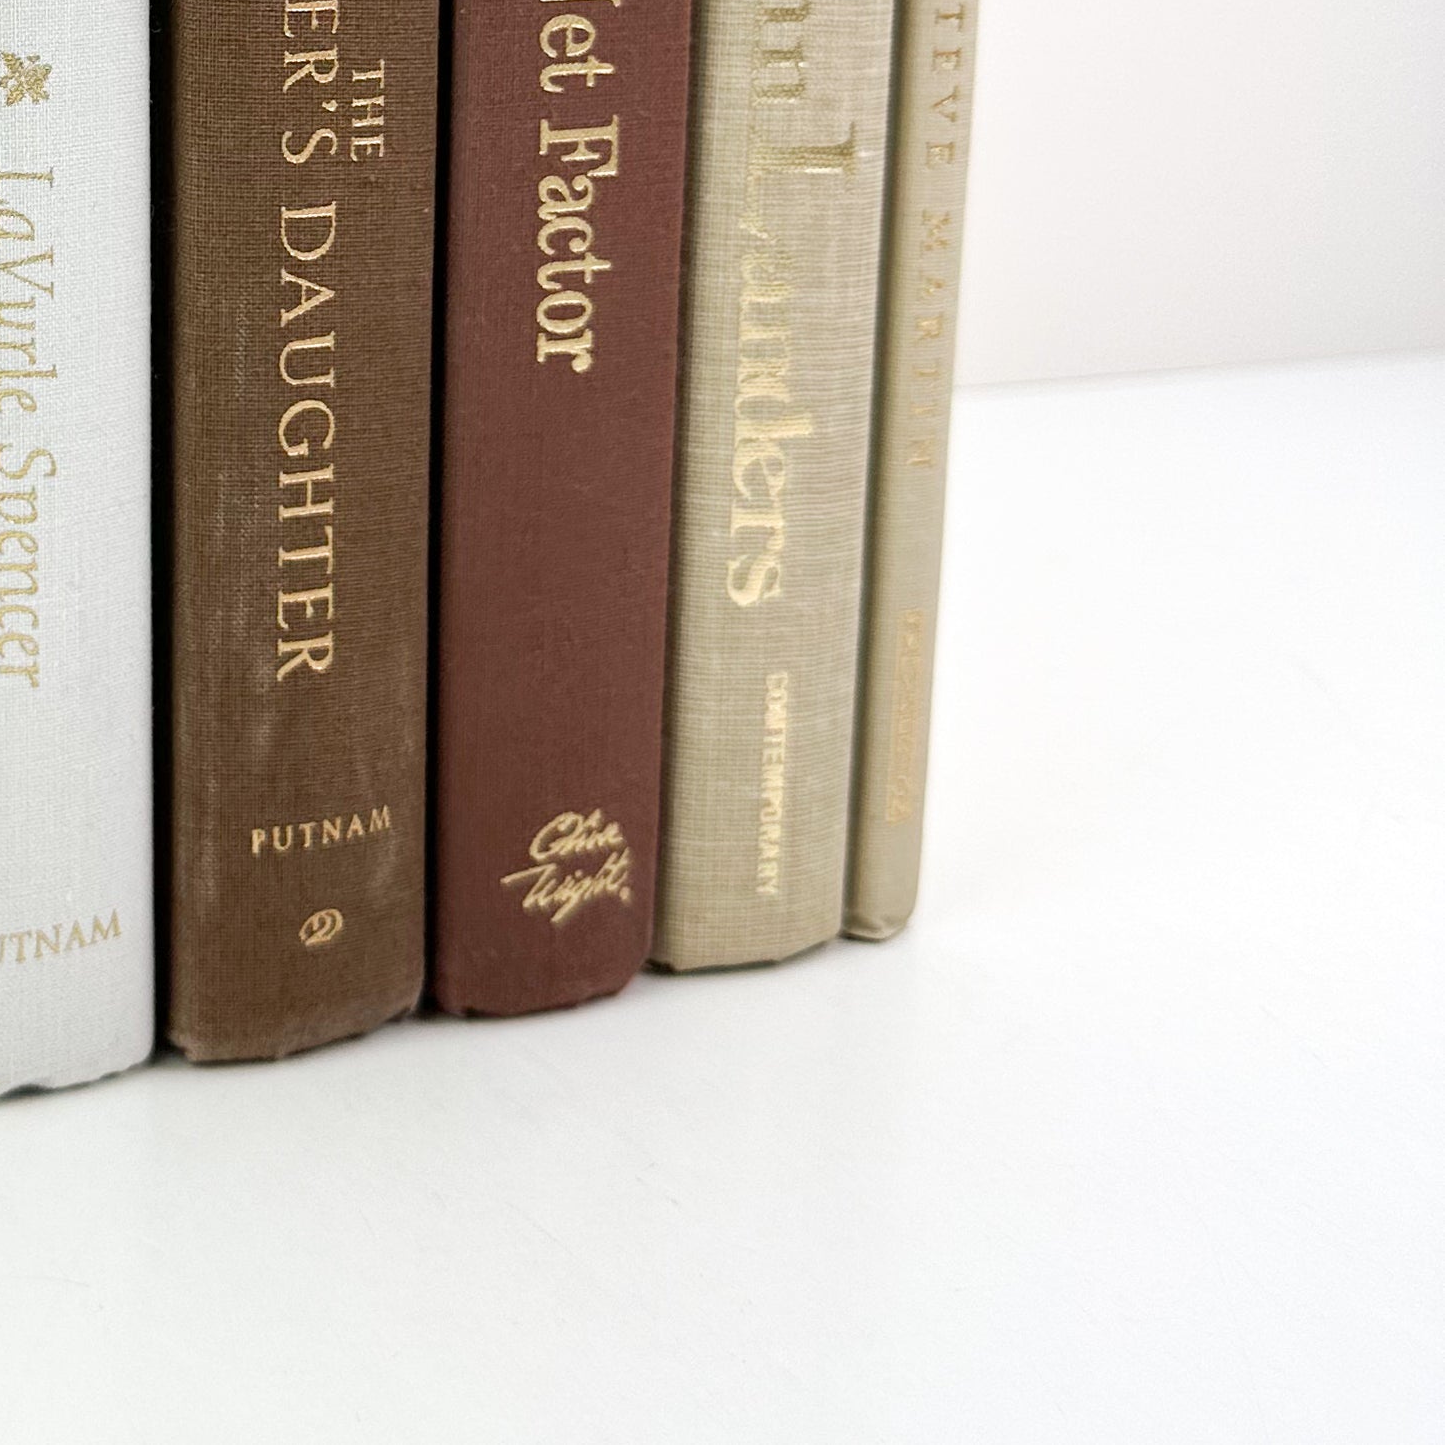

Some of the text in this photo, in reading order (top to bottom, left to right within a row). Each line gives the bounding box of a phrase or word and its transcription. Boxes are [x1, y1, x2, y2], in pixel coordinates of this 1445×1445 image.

[349, 57, 386, 163] THE
[535, 114, 621, 375] Factor
[725, 119, 857, 608] Landers
[276, 200, 338, 683] DAUGHTER
[250, 803, 393, 857] PUTNAM
[756, 670, 790, 897] CONTEMPORARY
